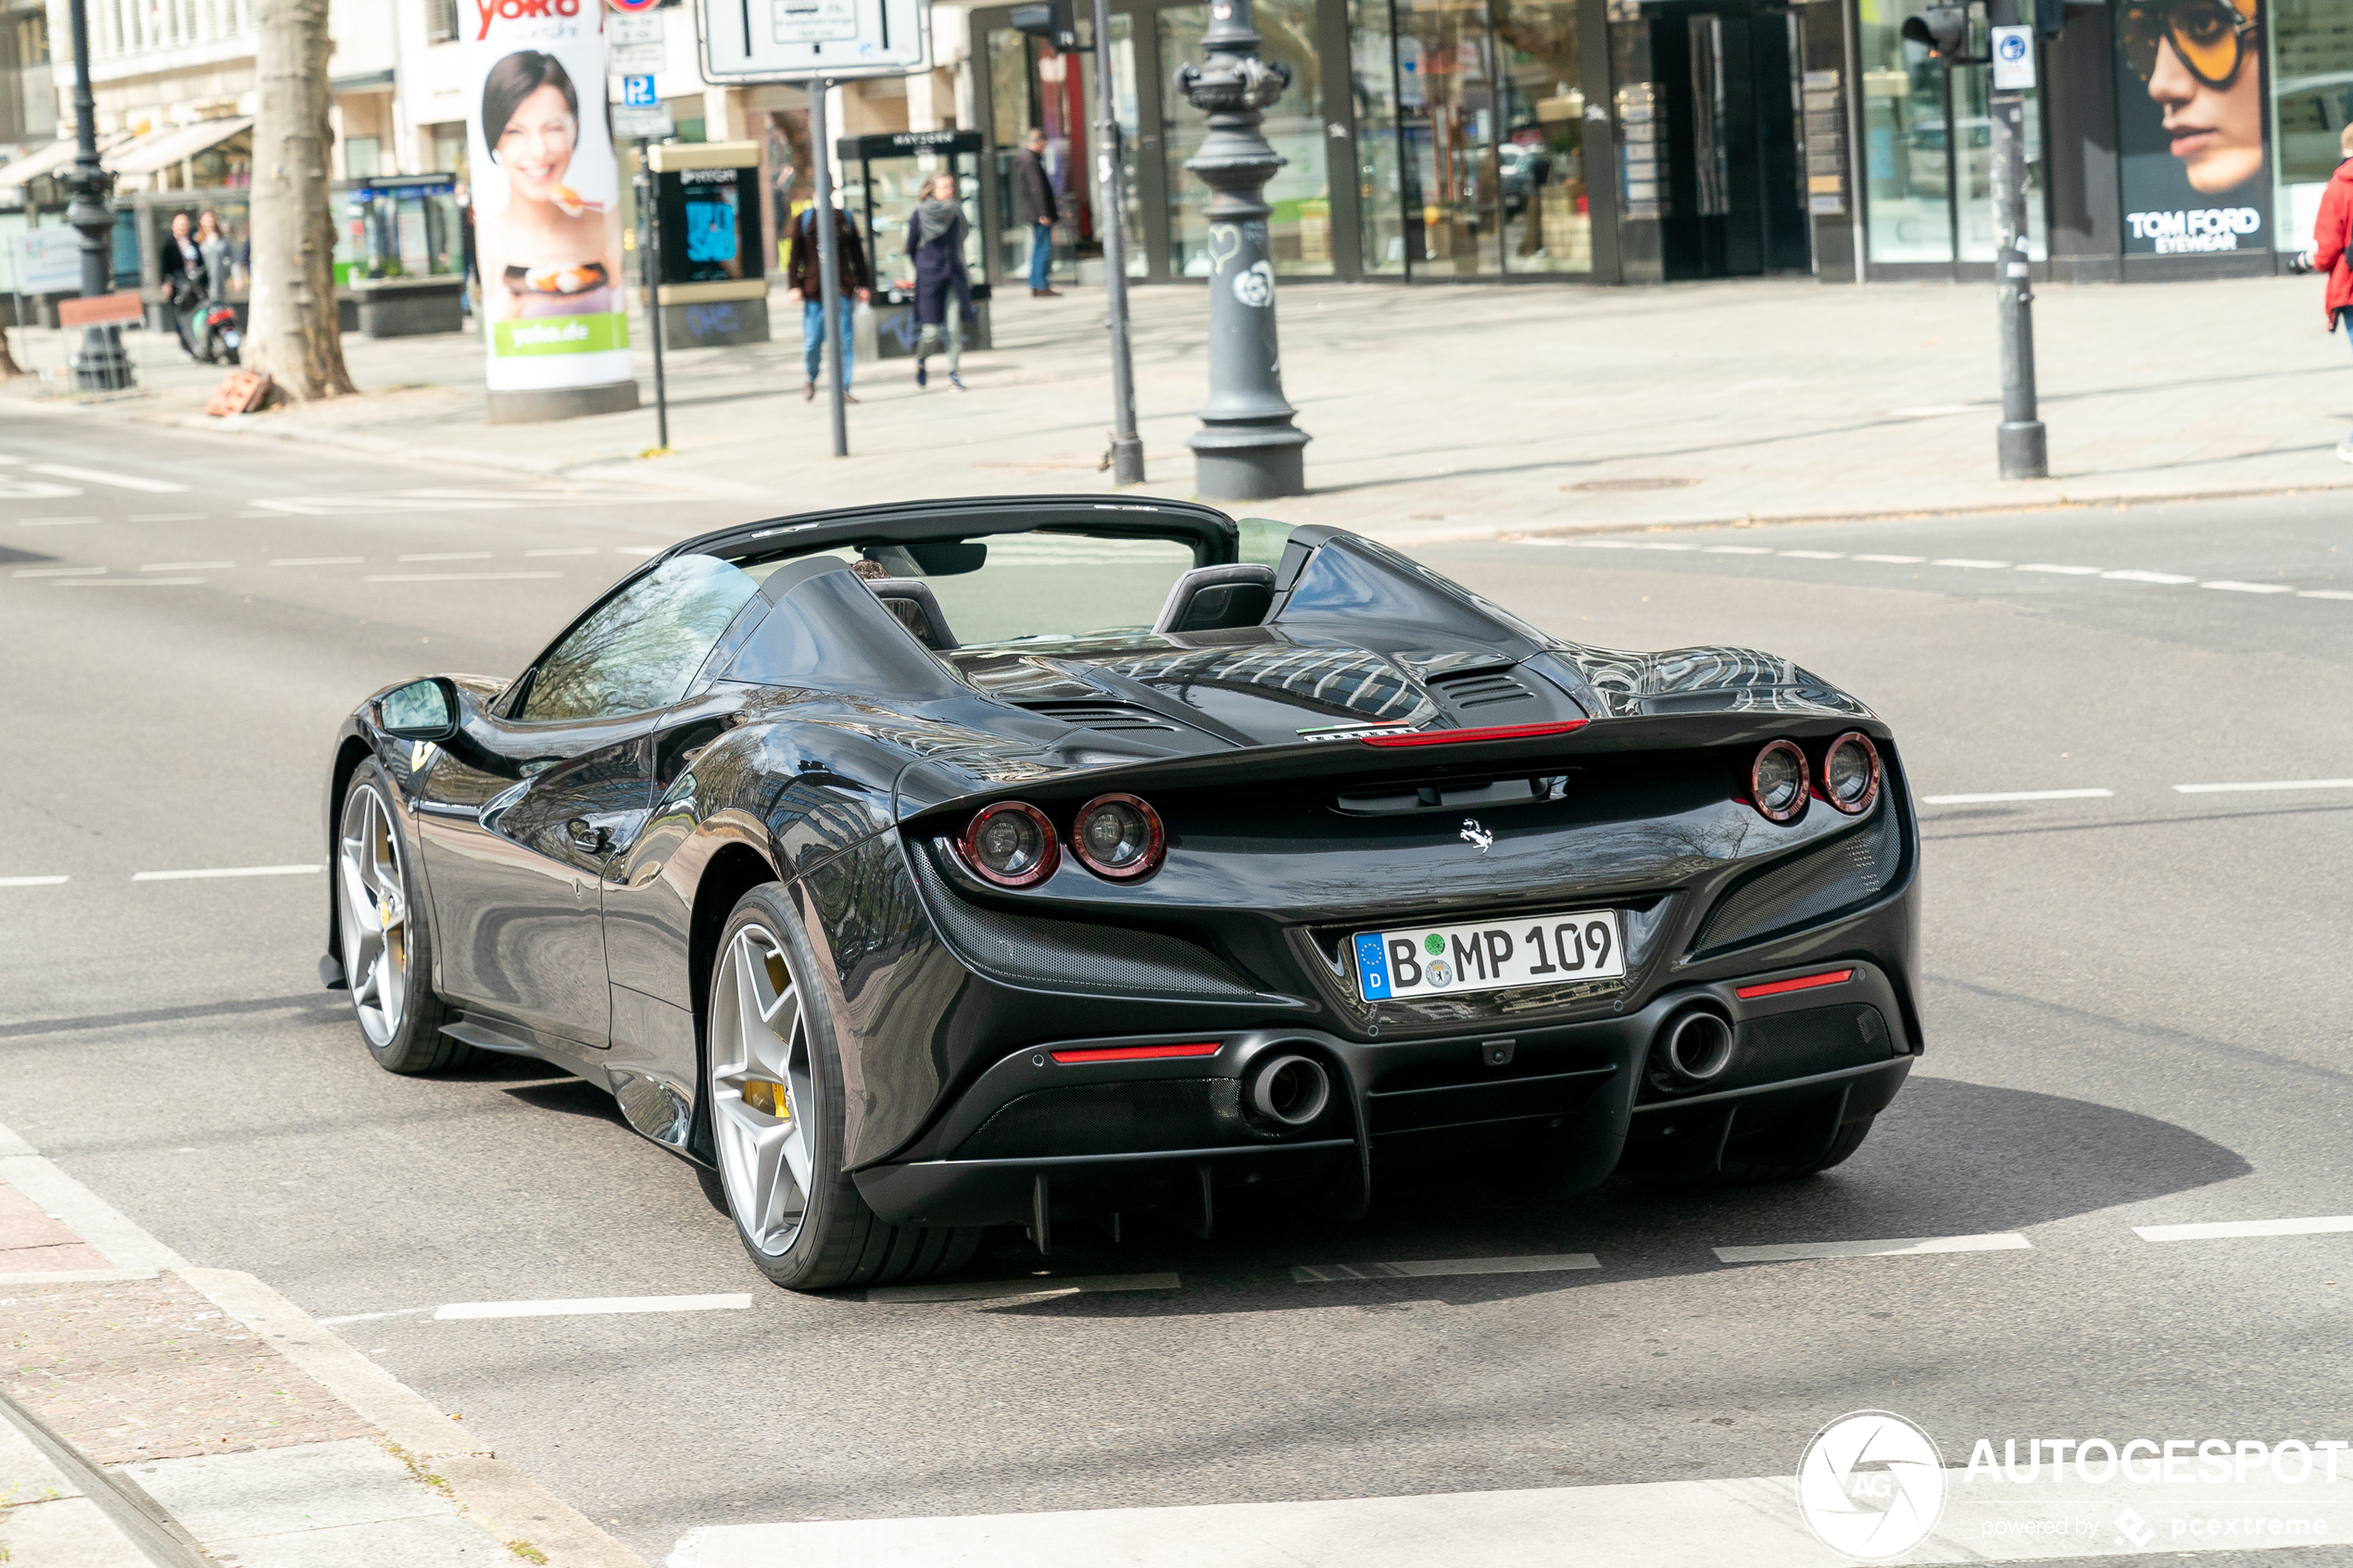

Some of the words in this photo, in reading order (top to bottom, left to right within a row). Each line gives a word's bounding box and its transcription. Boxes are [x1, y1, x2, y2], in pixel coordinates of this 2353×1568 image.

[2126, 210, 2185, 239] TOM
[2187, 207, 2261, 233] FORD
[2155, 232, 2237, 254] EYEWEAR
[1388, 938, 1422, 988] B
[1451, 930, 1514, 982] MP
[1525, 921, 1612, 974] 109
[1369, 972, 1381, 988] D
